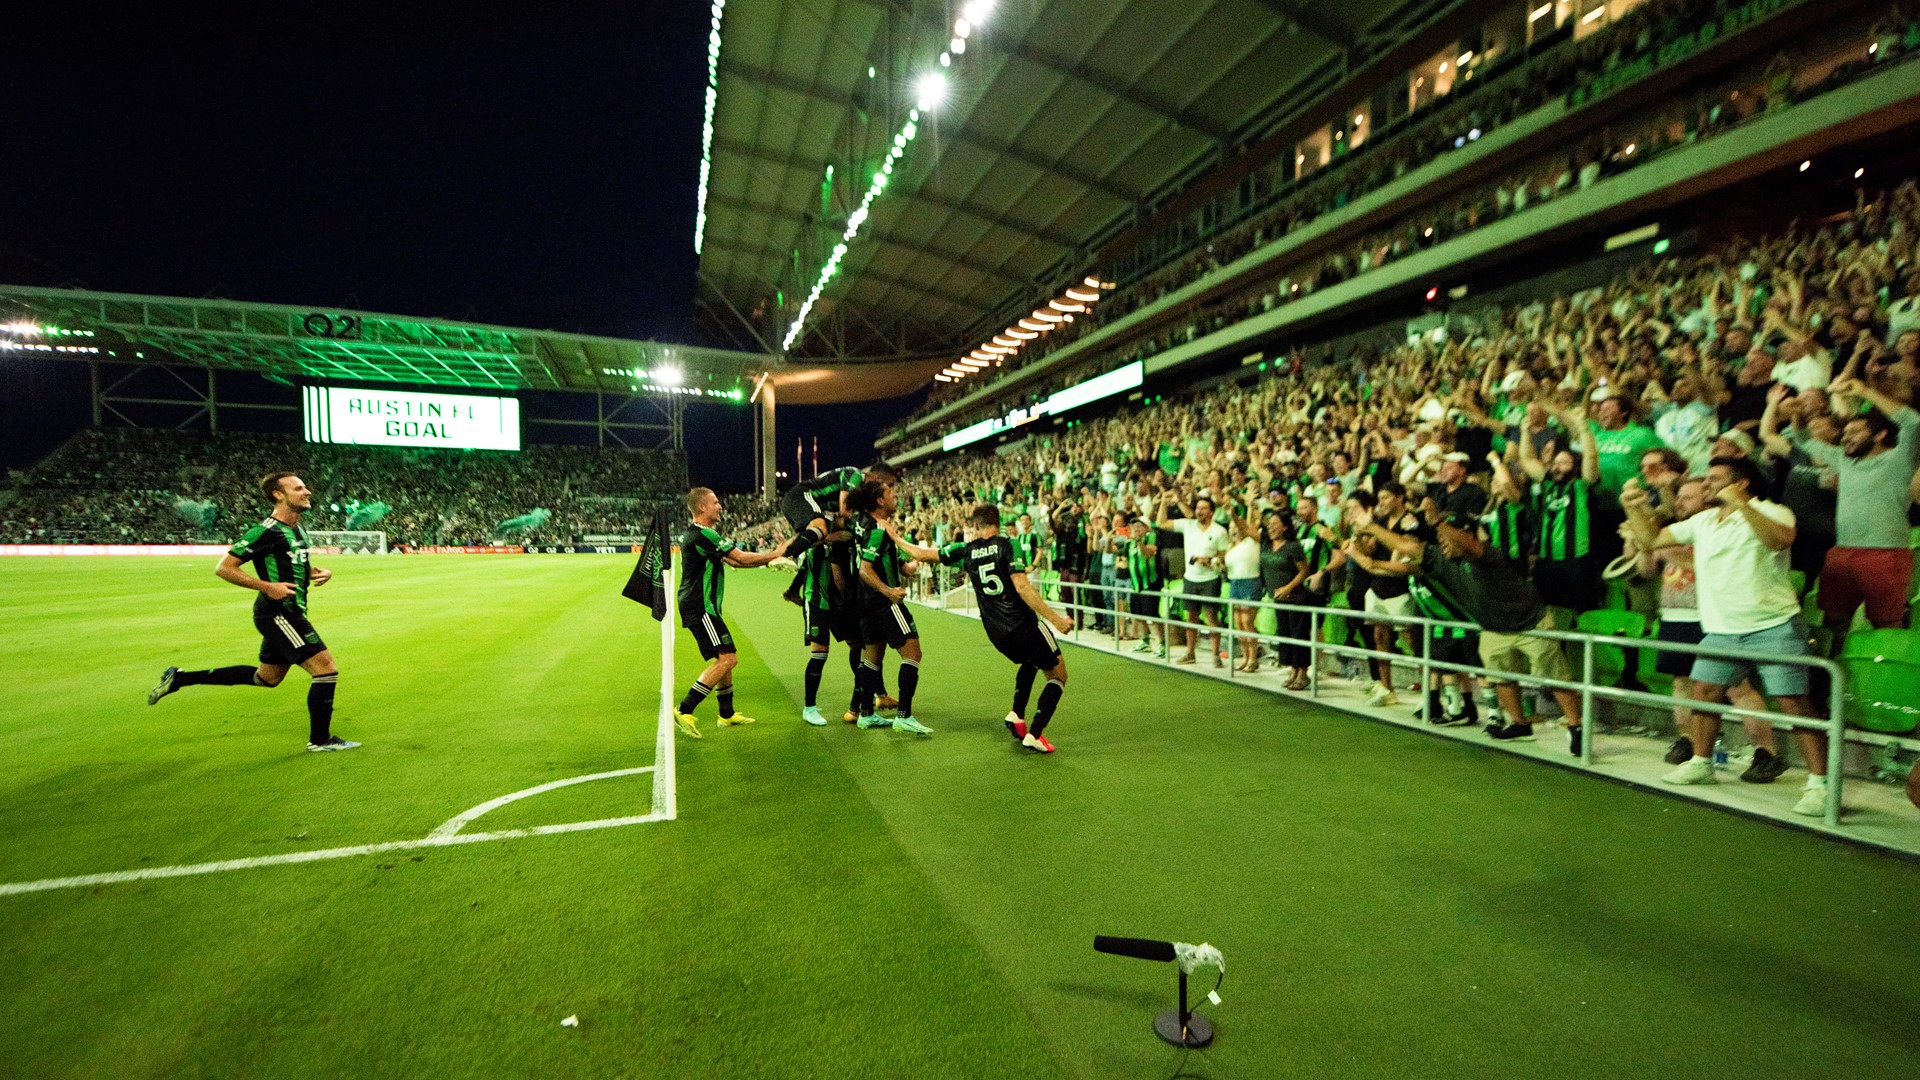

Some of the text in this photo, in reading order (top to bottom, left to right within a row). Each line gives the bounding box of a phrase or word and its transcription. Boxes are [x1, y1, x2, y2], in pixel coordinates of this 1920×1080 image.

[349, 398, 481, 420] AUSTIN FC
[386, 421, 453, 439] GOAL
[405, 545, 435, 554] WLLS
[595, 546, 616, 555] YETI
[978, 562, 1004, 595] 5
